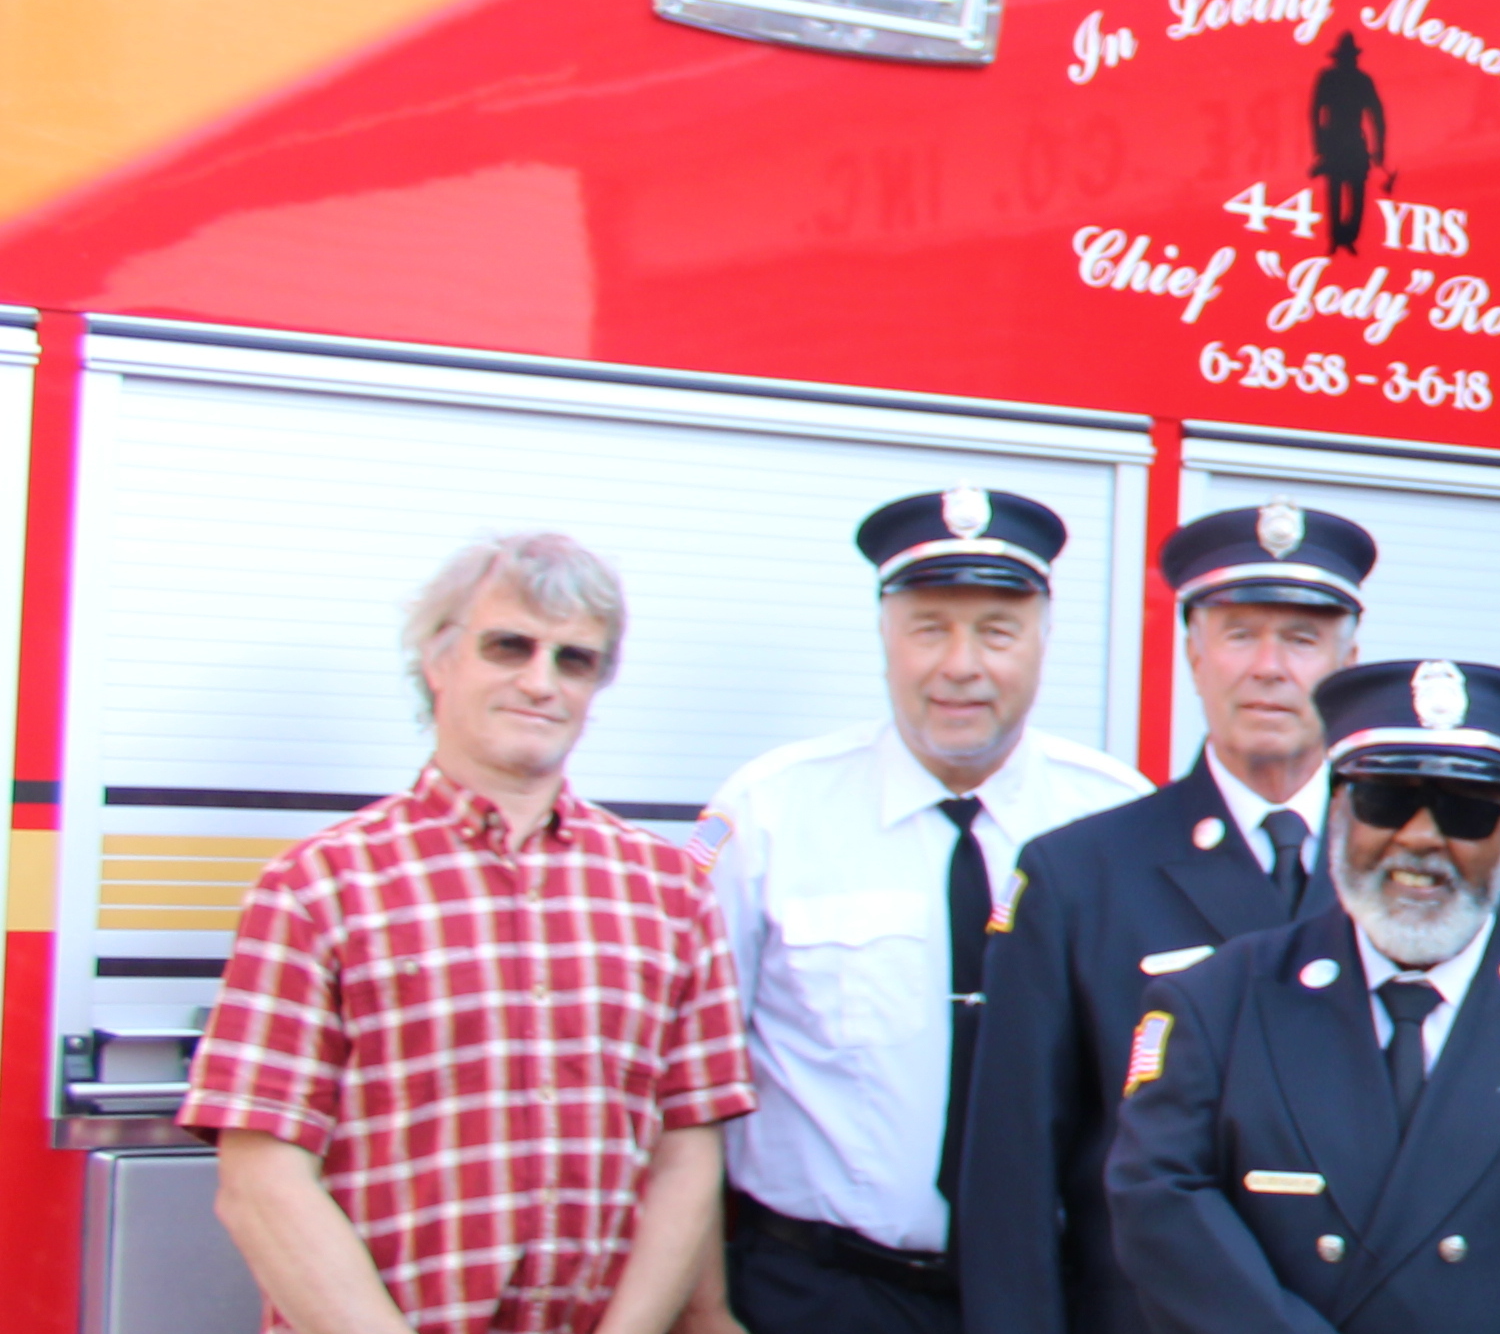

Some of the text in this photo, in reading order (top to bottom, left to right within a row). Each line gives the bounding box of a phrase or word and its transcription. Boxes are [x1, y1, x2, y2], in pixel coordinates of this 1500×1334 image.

[1067, 10, 1138, 85] In
[1222, 182, 1470, 258] 44 YRS
[1072, 225, 1237, 324] Chief
[1199, 340, 1350, 396] 6-28-58
[1383, 361, 1493, 412] 3-6-18
